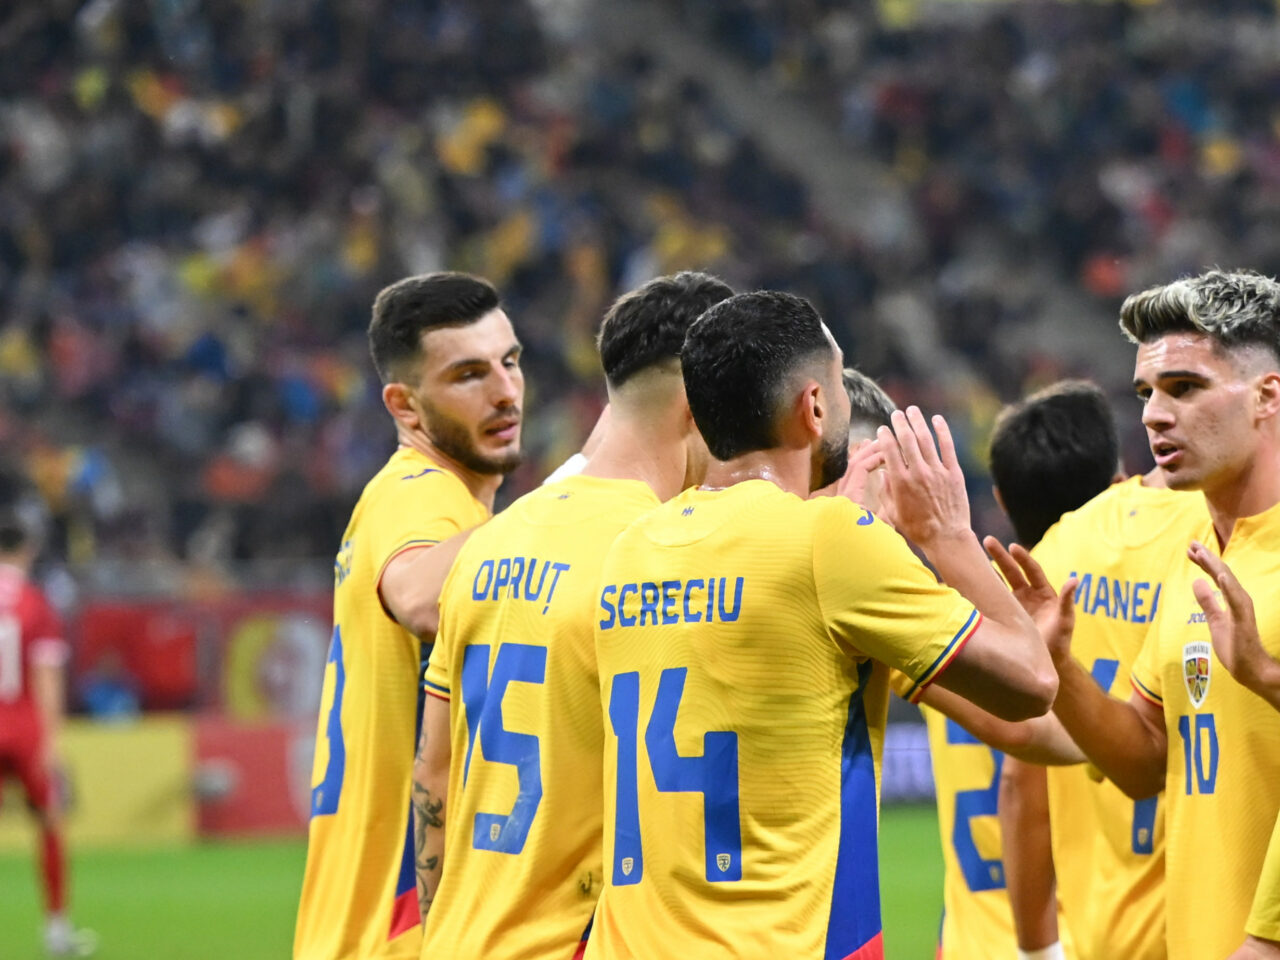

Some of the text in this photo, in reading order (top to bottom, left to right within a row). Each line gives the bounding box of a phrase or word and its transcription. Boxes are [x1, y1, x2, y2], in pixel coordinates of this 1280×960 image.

[472, 556, 571, 615] OPRUȚ
[599, 576, 744, 630] SCRECIU
[461, 642, 548, 855] 15
[608, 667, 742, 887] 14
[1178, 713, 1219, 796] 10
